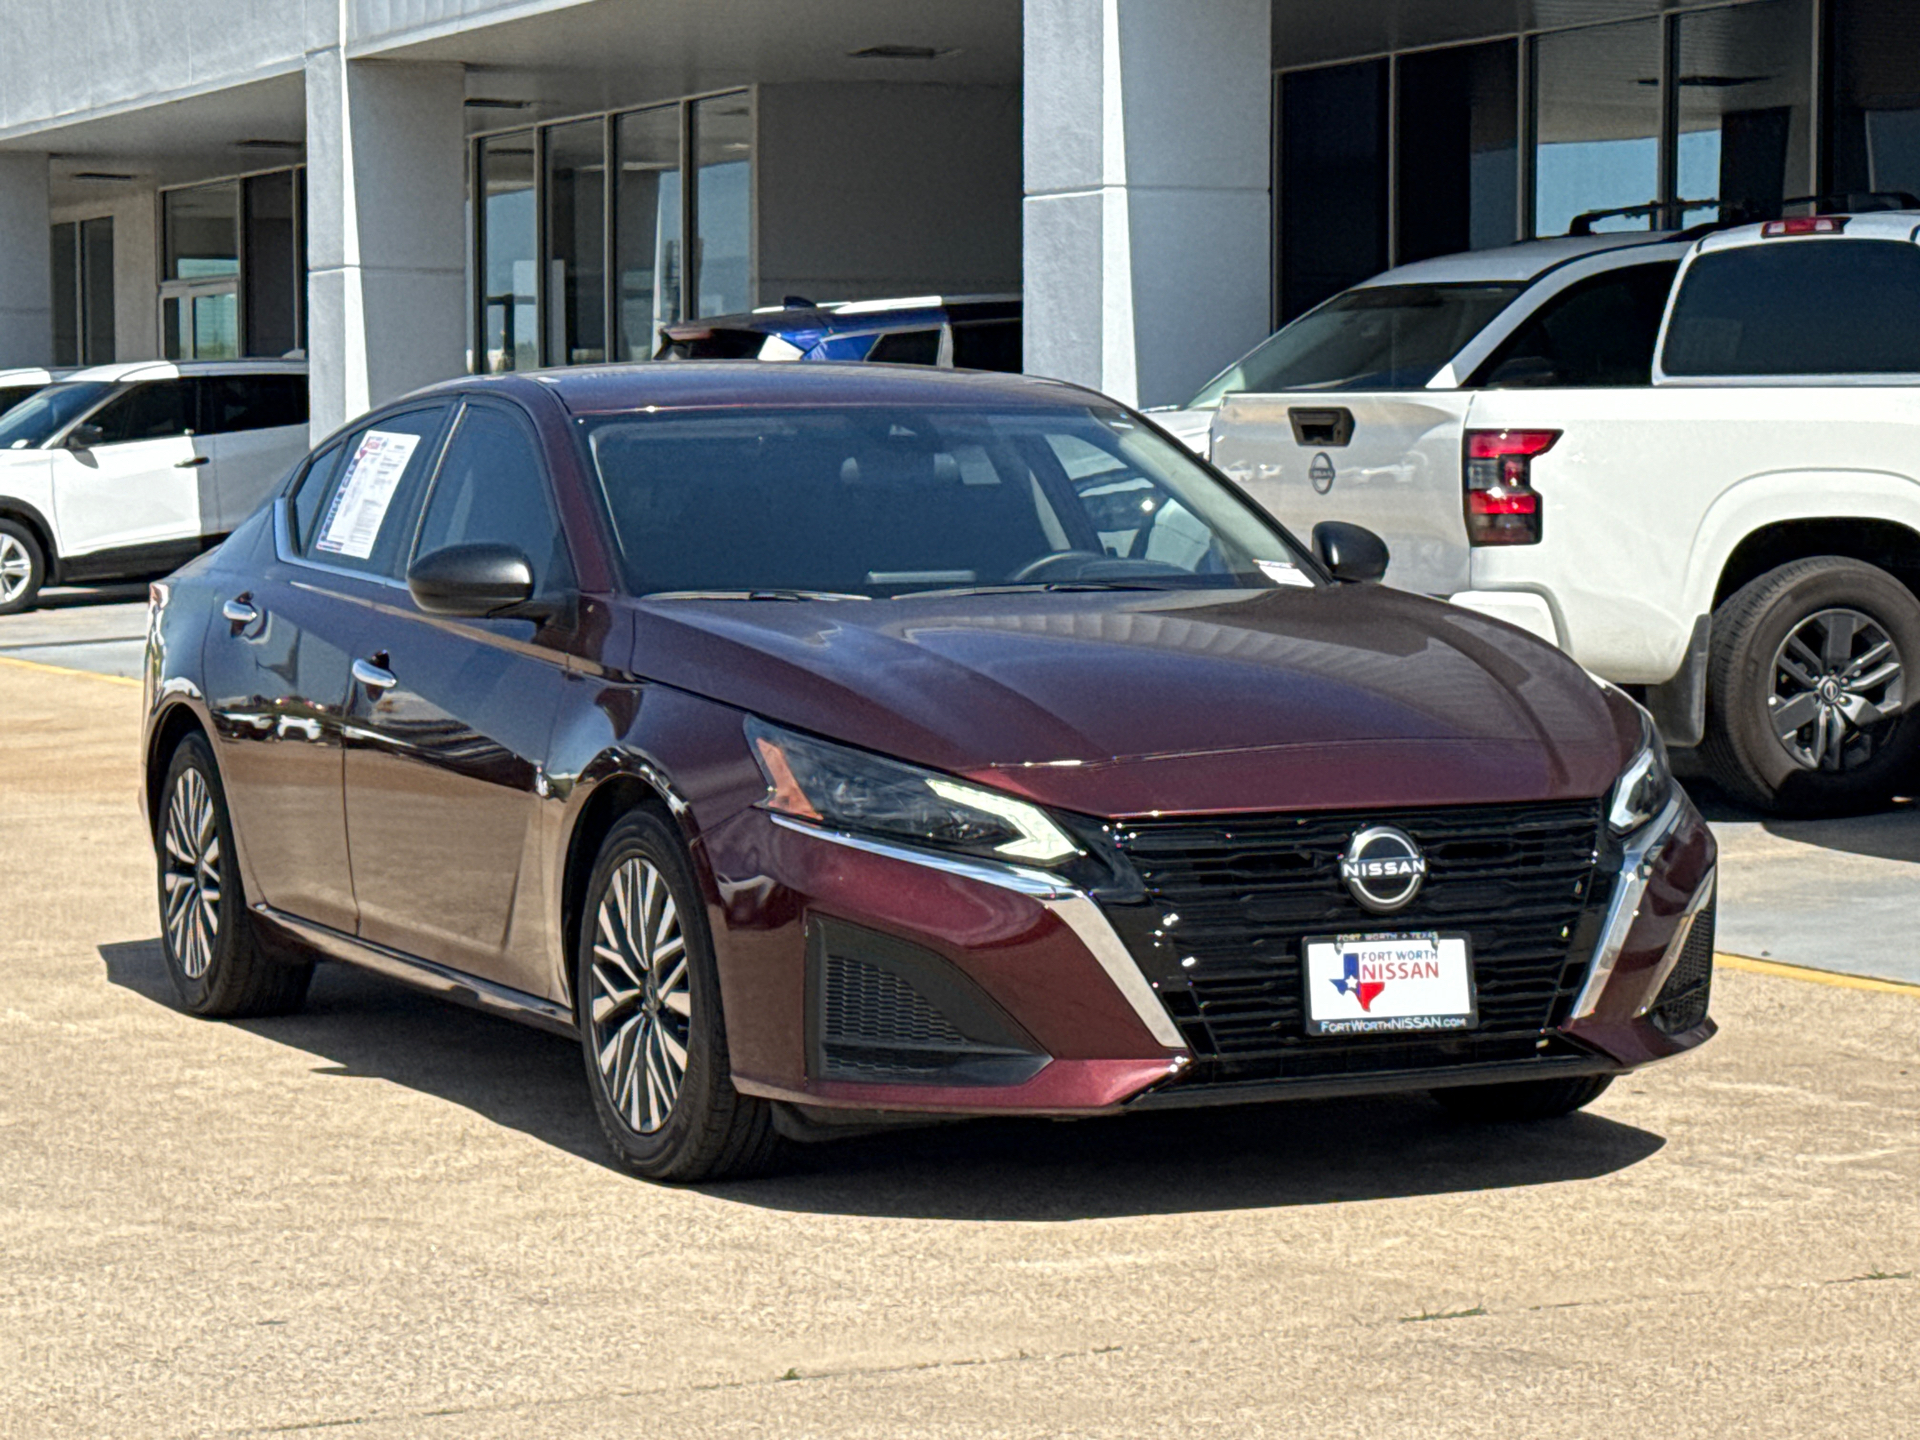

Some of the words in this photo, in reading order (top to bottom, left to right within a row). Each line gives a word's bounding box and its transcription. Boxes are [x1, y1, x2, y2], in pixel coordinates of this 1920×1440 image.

[1343, 859, 1425, 877] NISSAN
[1361, 951, 1392, 961] FORT
[1395, 950, 1438, 961] WORTH
[1362, 961, 1439, 980] NISSAN
